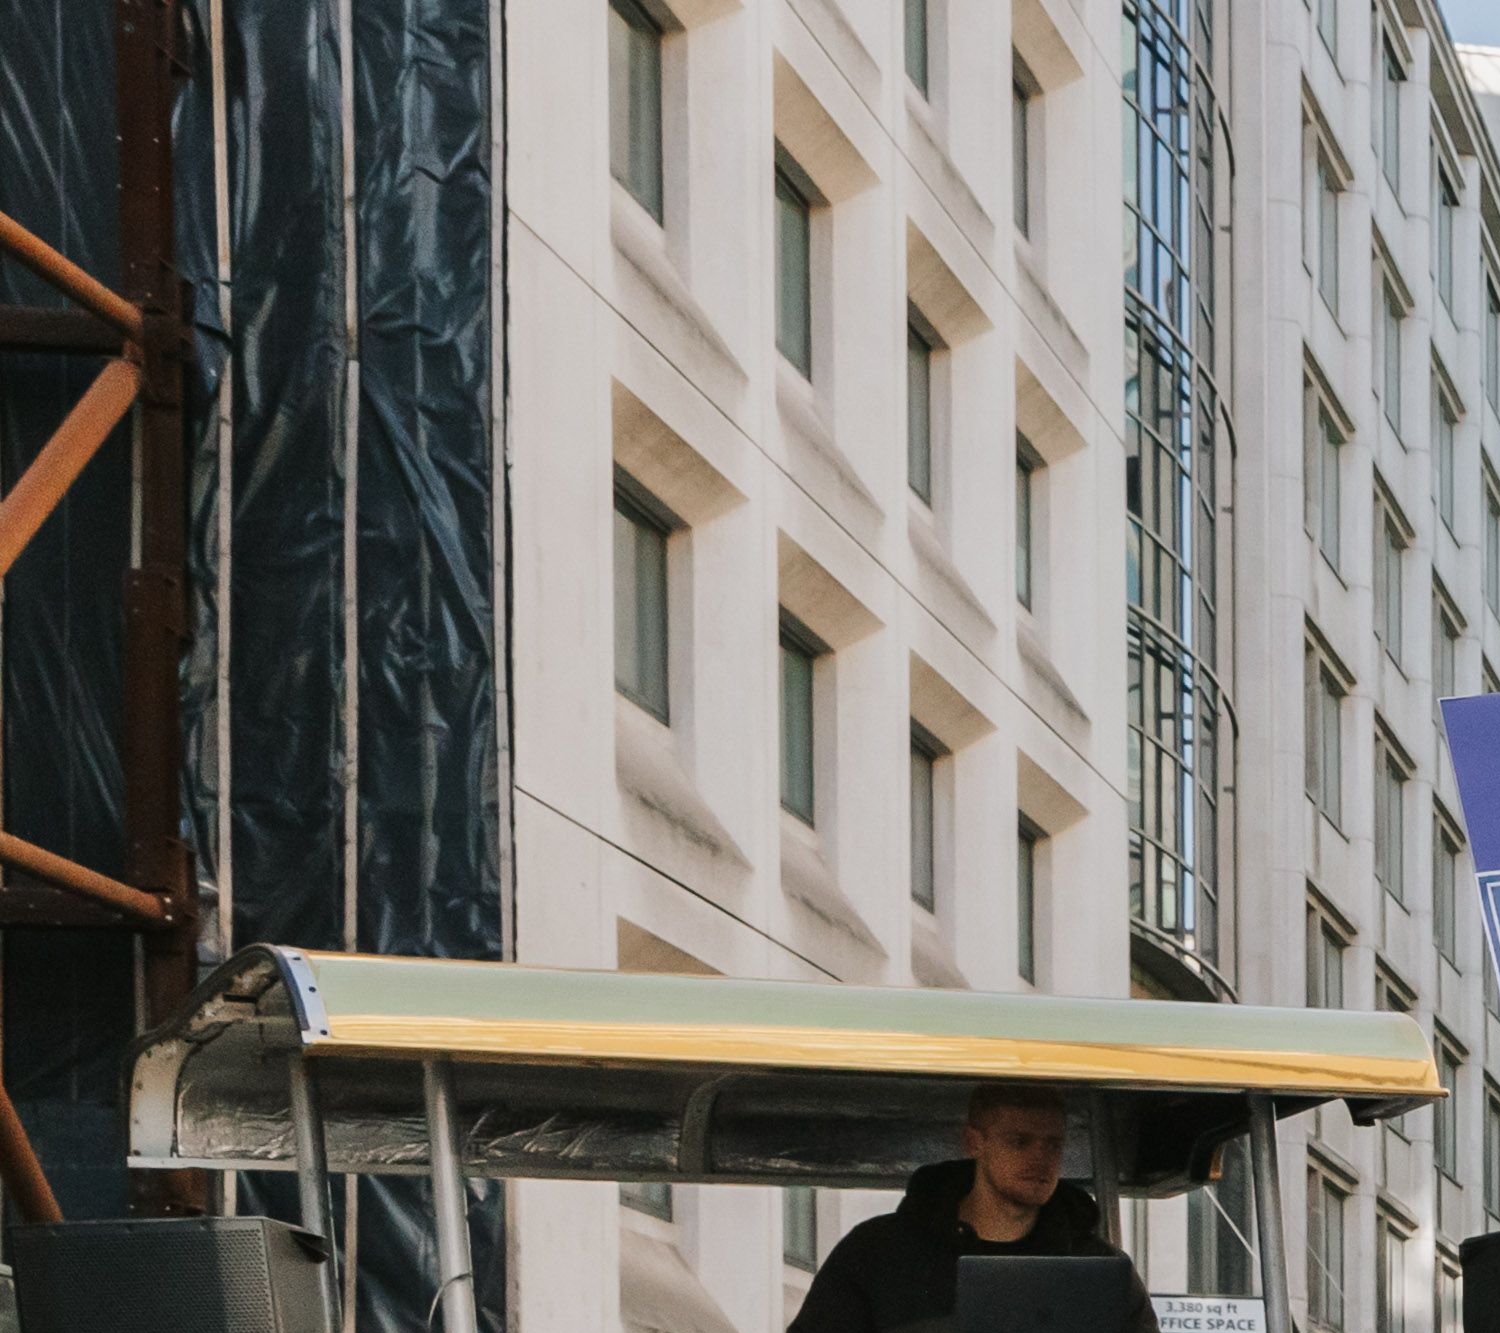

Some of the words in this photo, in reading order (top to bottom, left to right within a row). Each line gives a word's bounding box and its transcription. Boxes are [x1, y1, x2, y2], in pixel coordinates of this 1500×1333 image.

[1206, 1304, 1223, 1315] sq
[1227, 1302, 1238, 1314] ft
[1160, 1317, 1201, 1330] FFICE
[1206, 1318, 1256, 1331] SPACE
